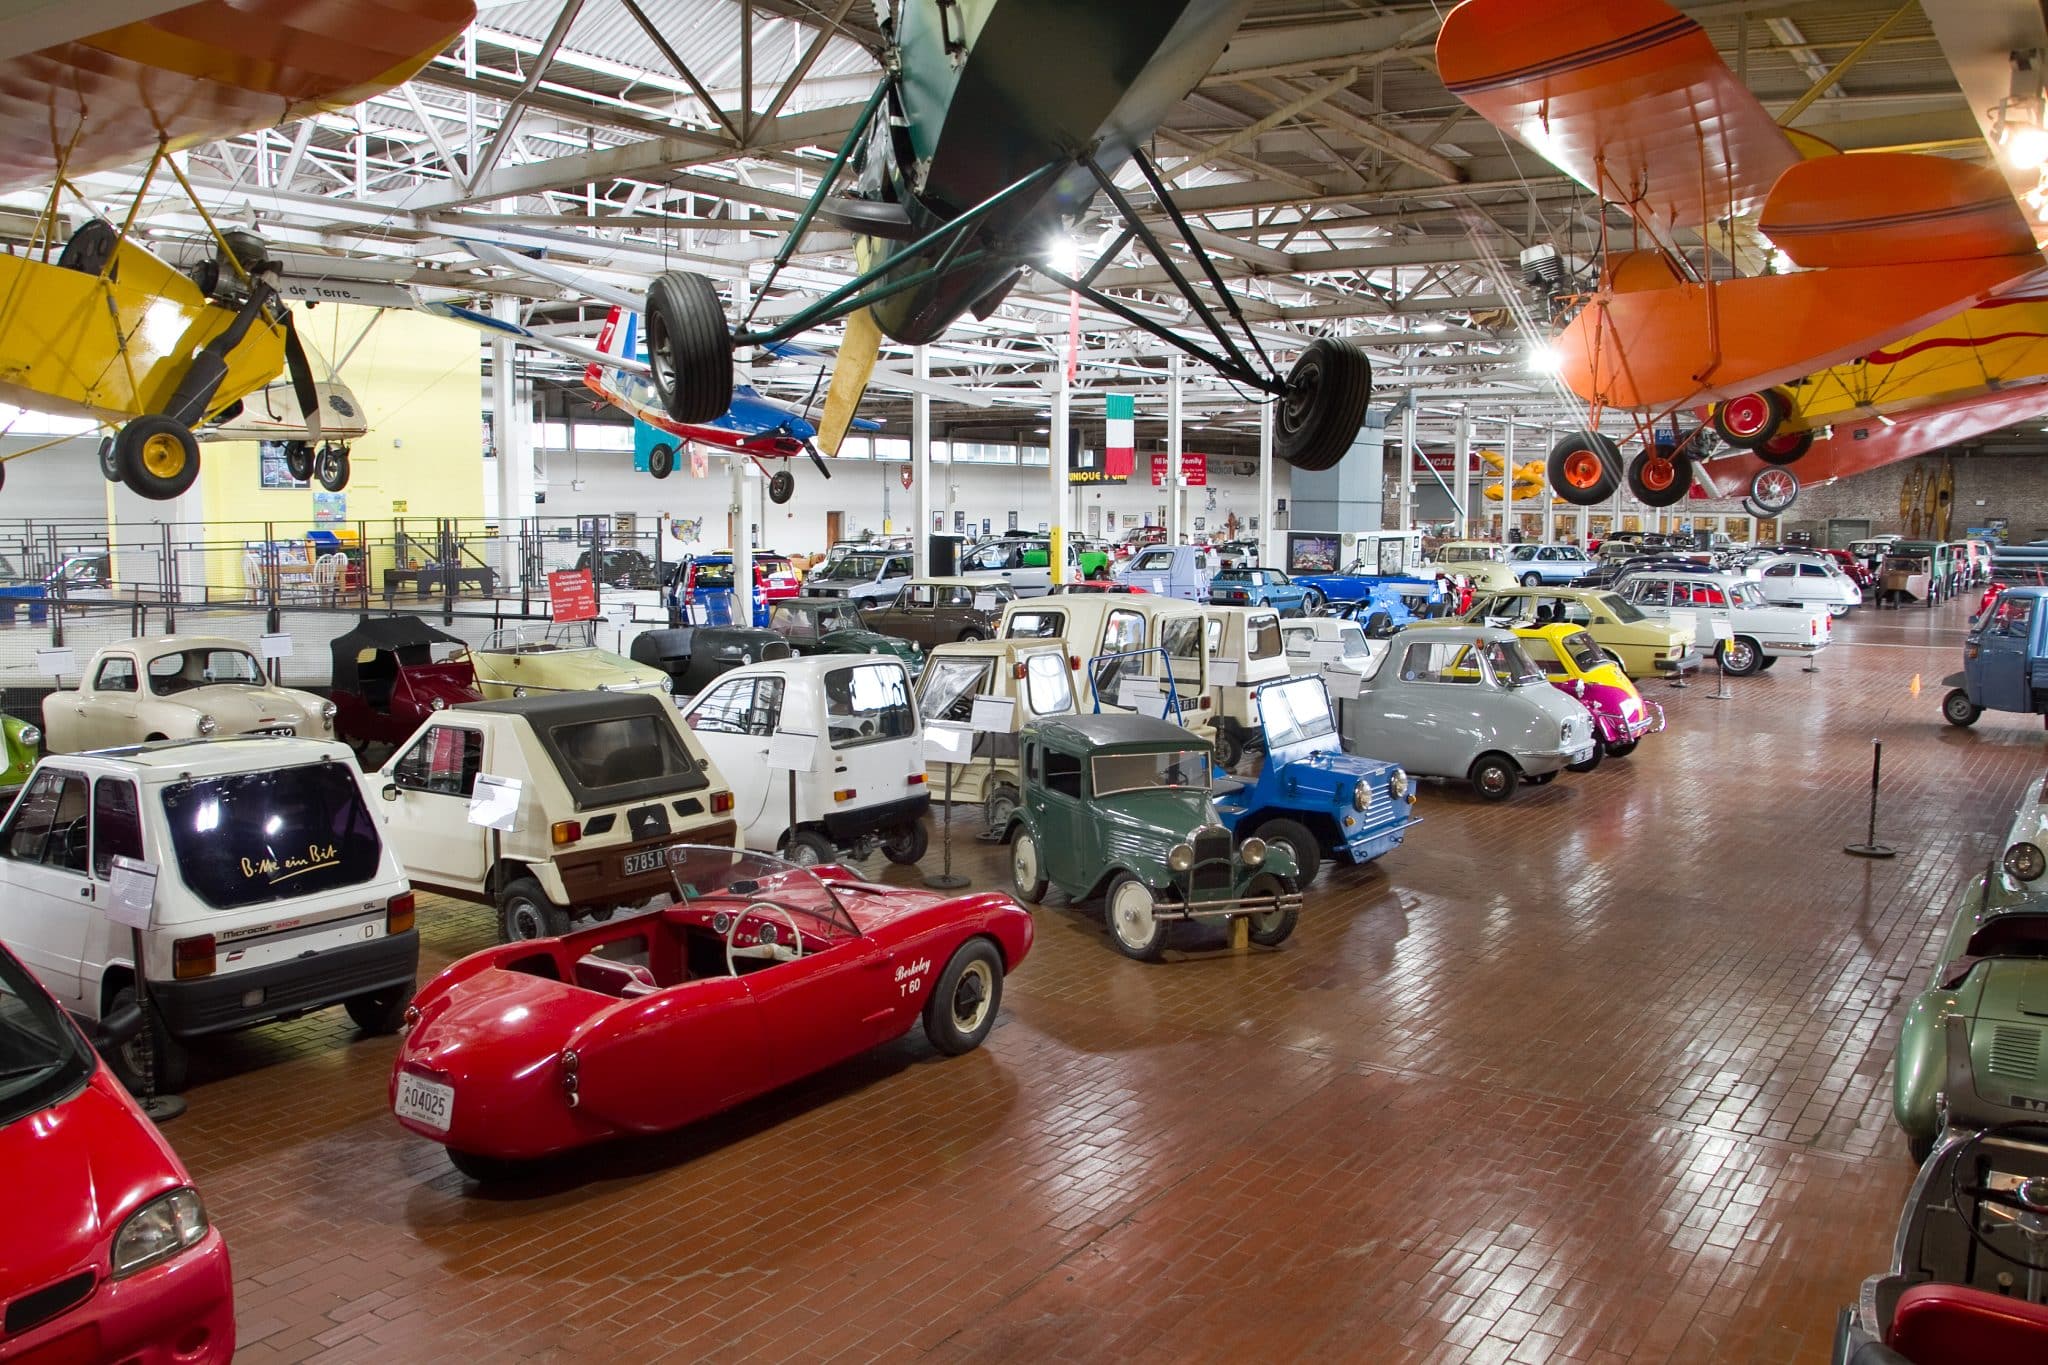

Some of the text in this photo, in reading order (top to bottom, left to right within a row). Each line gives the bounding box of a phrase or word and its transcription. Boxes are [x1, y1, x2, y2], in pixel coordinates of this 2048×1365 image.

[289, 285, 307, 296] de
[606, 322, 616, 345] 7
[285, 856, 308, 868] ein
[309, 844, 338, 863] Bit
[626, 851, 655, 873] 5785
[900, 978, 920, 997] T 60
[411, 1088, 446, 1117] 04025
